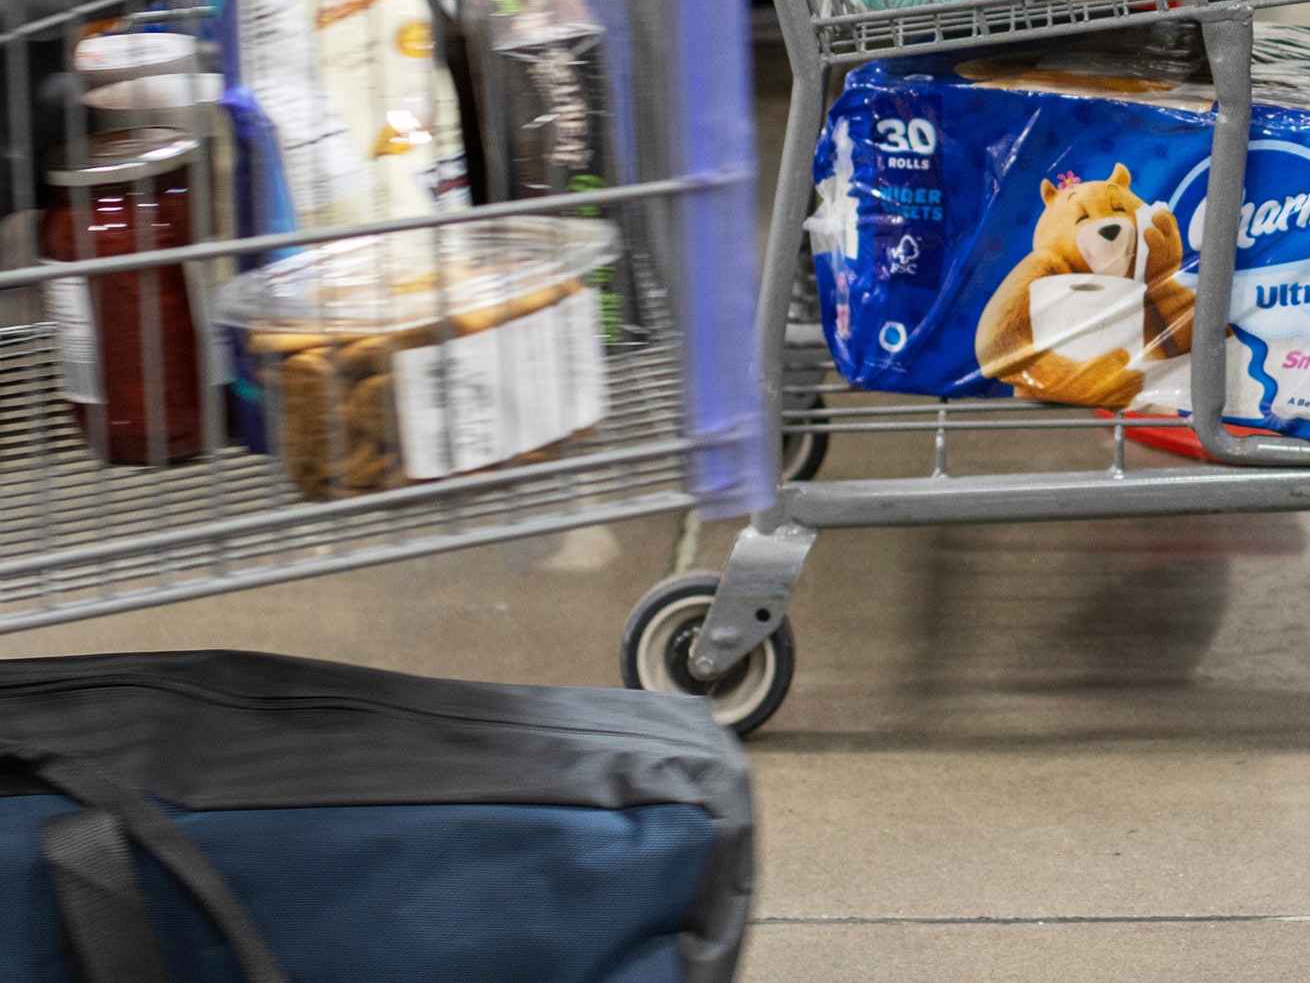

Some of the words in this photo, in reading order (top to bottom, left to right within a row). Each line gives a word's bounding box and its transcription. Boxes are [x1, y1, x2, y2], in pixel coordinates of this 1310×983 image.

[876, 118, 936, 154] 30
[888, 157, 930, 169] ROLLS
[1287, 397, 1295, 405] A
